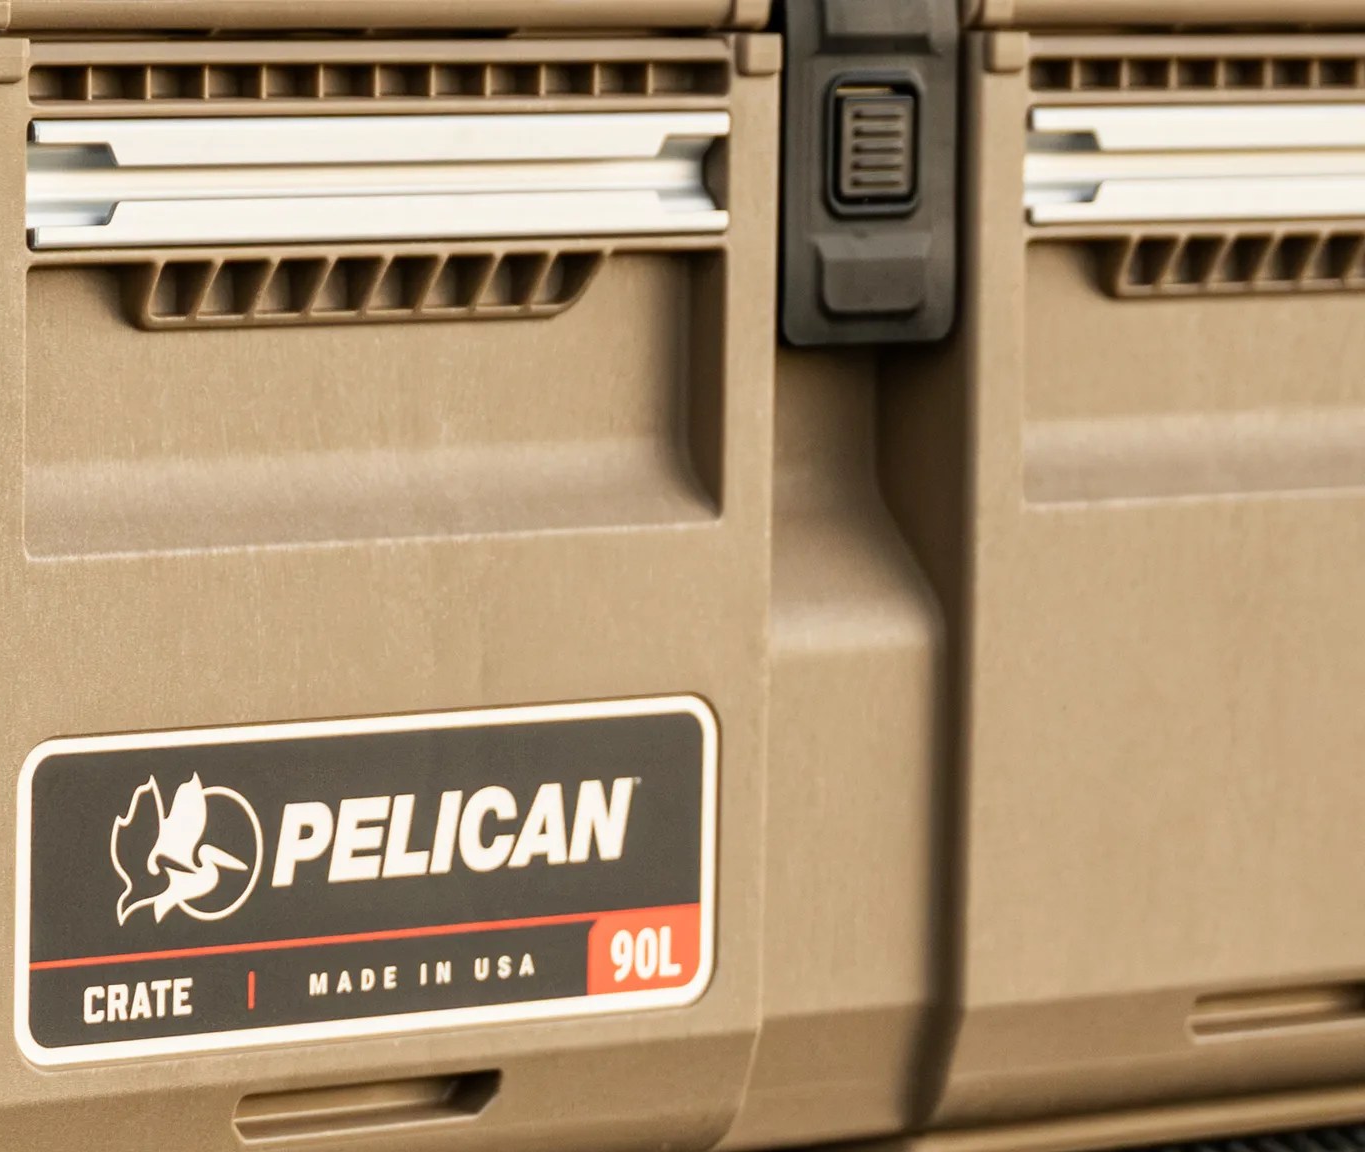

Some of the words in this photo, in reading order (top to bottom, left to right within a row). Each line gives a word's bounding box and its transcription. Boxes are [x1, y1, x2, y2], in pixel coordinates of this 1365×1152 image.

[271, 777, 633, 887] PELICAN
[309, 966, 397, 995] MADE
[420, 961, 451, 985] IN
[474, 953, 536, 980] USA
[610, 926, 682, 983] 90L
[83, 977, 193, 1024] CRATE
